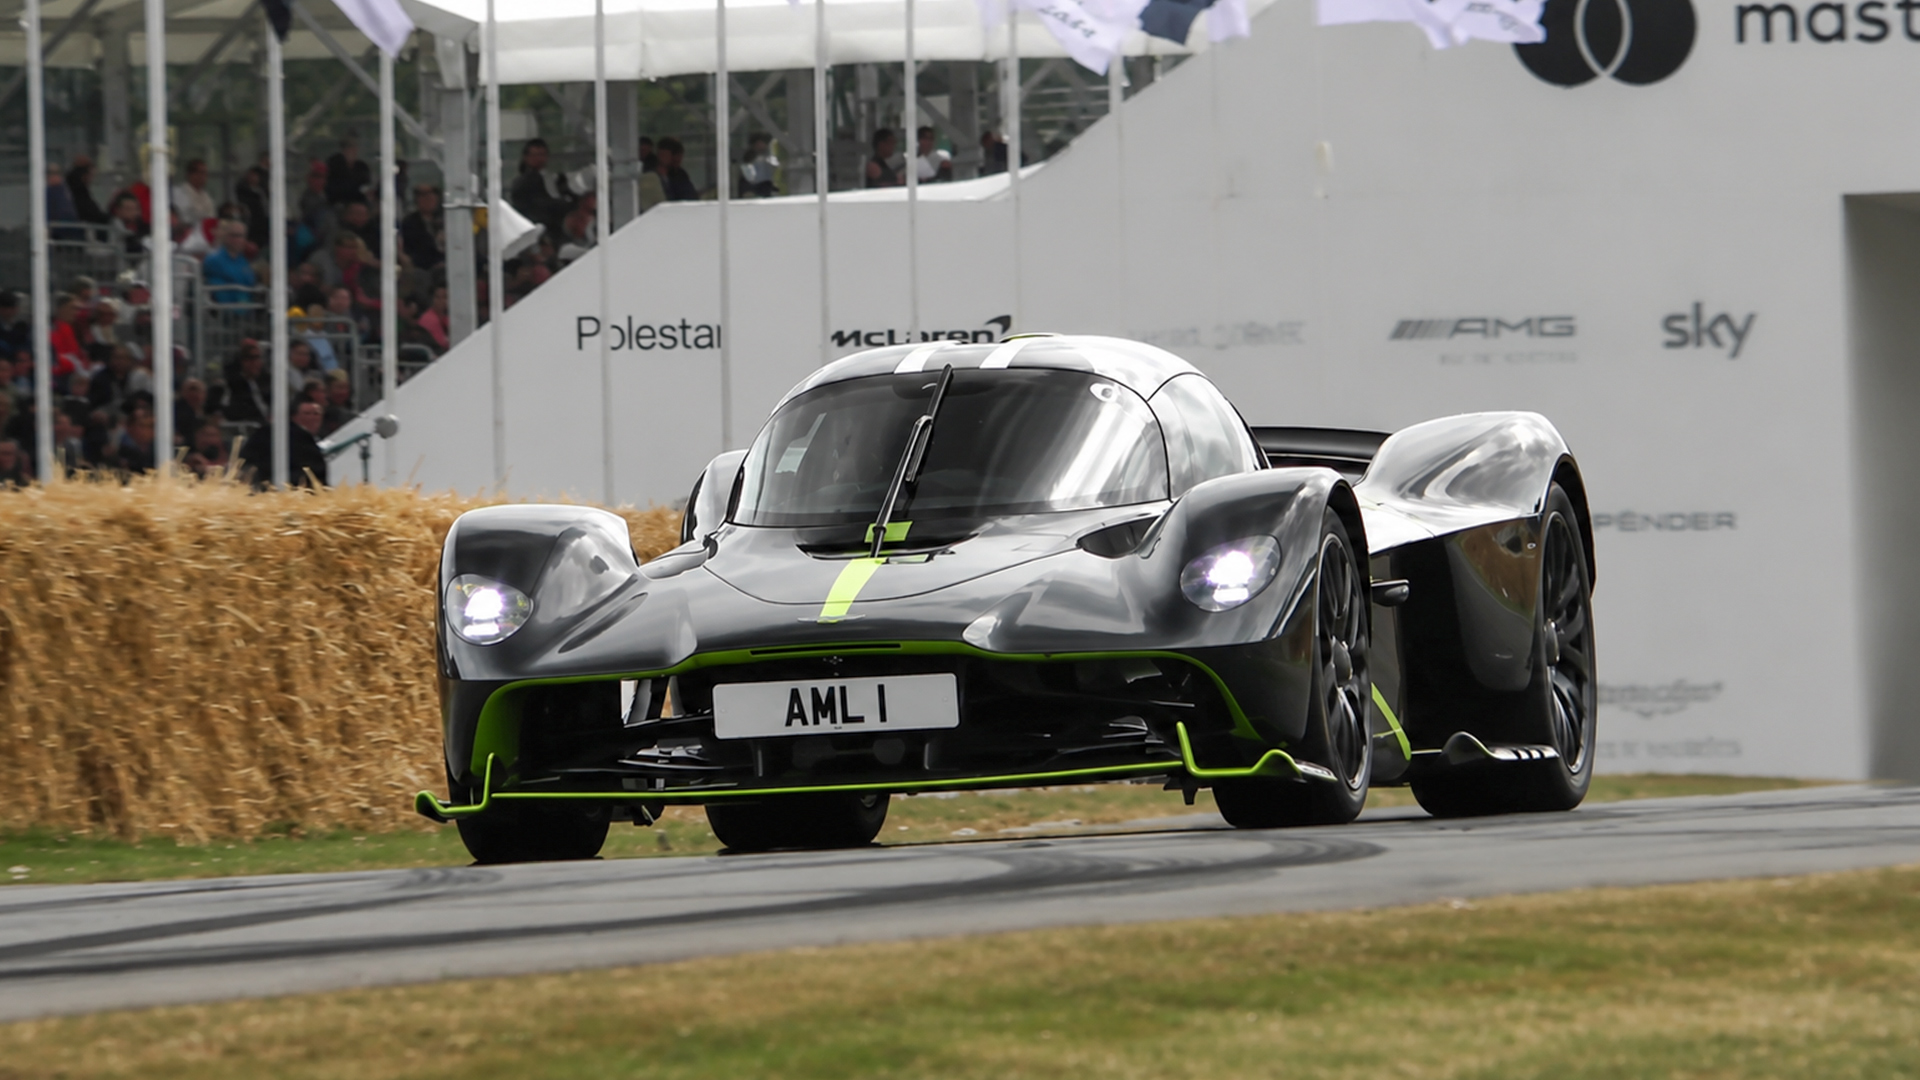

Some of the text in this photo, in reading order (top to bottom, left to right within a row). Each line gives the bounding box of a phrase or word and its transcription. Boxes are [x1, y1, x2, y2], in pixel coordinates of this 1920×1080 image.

[1450, 315, 1577, 340] AMG
[1662, 301, 1757, 360] sky
[785, 685, 865, 727] AML
